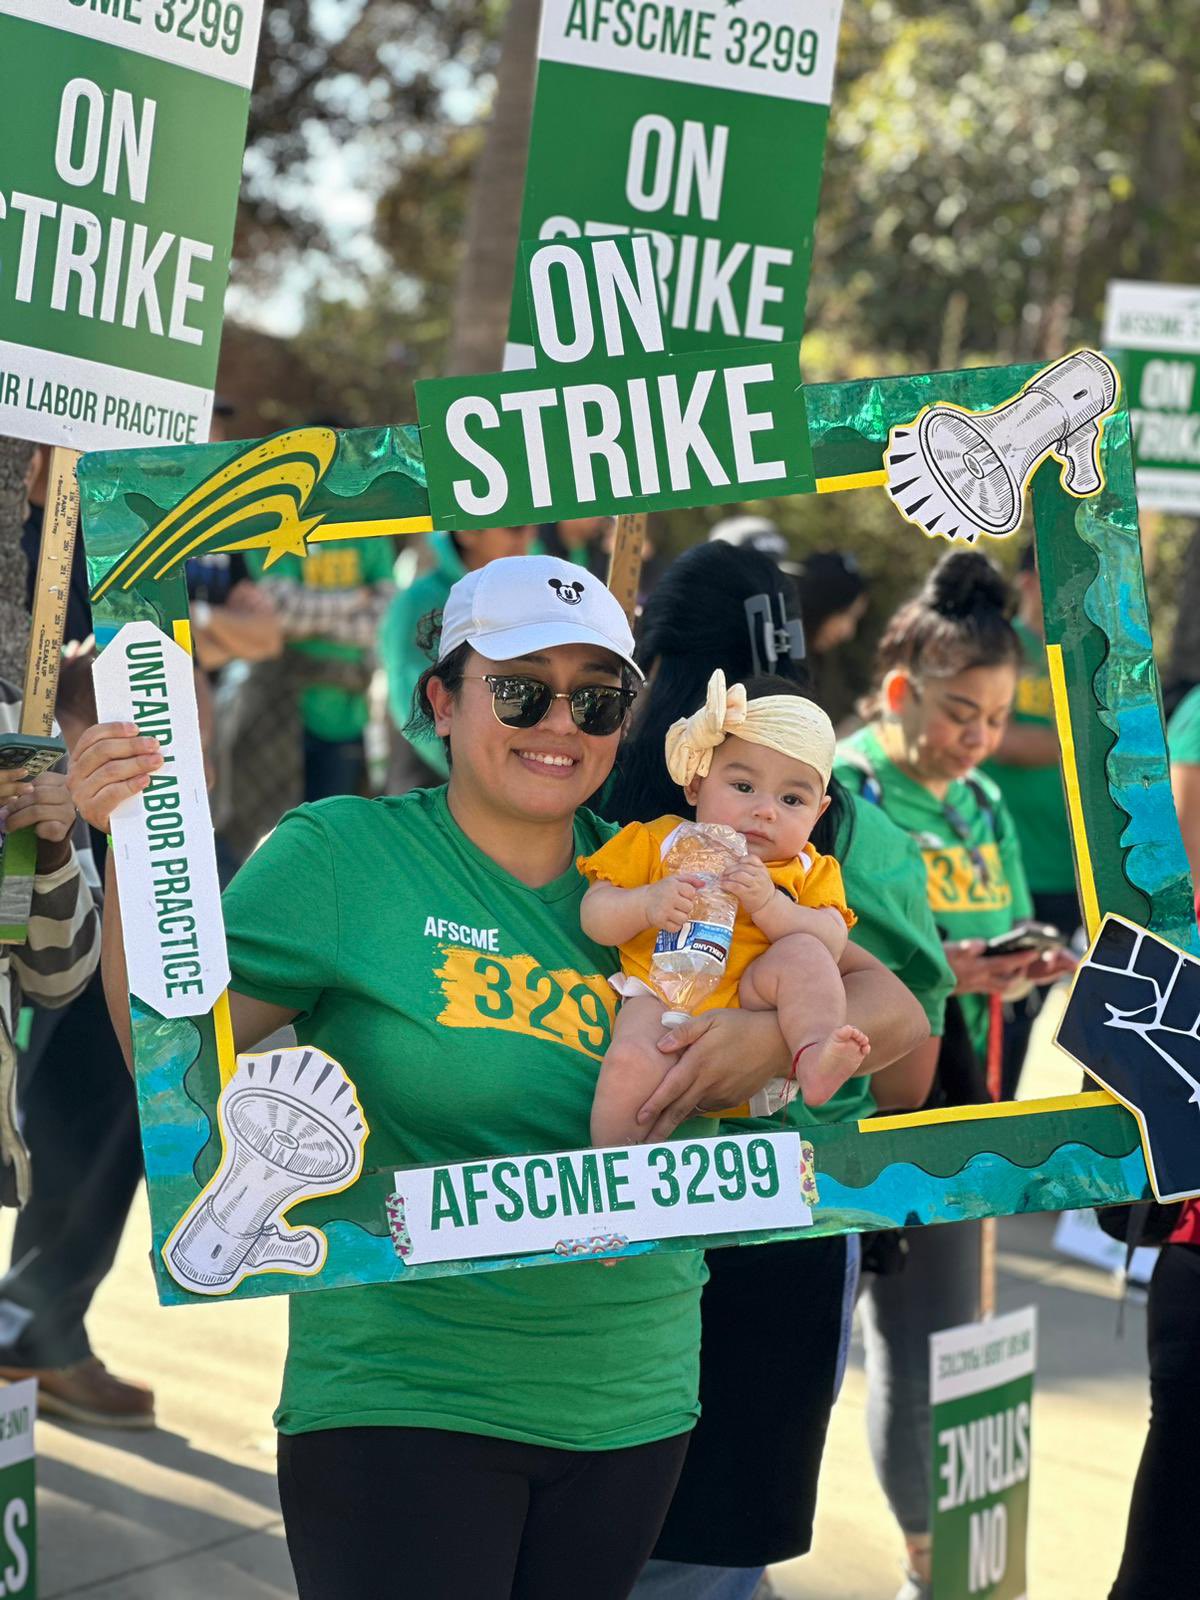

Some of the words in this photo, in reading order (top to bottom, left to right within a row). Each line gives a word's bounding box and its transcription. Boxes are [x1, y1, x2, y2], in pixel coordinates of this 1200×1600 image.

[564, 0, 716, 60] AFSCME
[725, 17, 818, 76] 3299
[55, 77, 156, 204] ON
[625, 114, 729, 221] ON
[0, 190, 214, 347] TRIKE
[529, 237, 665, 363] ON
[25, 378, 98, 423] LABOR
[102, 394, 199, 444] PRACTICE
[1140, 358, 1196, 411] ON
[444, 363, 787, 516] STRIKE
[151, 857, 203, 998] PRACTICE
[424, 916, 499, 952] AFSCME
[474, 957, 621, 1057] 329
[430, 1150, 636, 1231] AFSCME
[646, 1138, 780, 1208] 3299
[938, 1401, 1030, 1513] STRIKE
[968, 1503, 1007, 1593] ON
